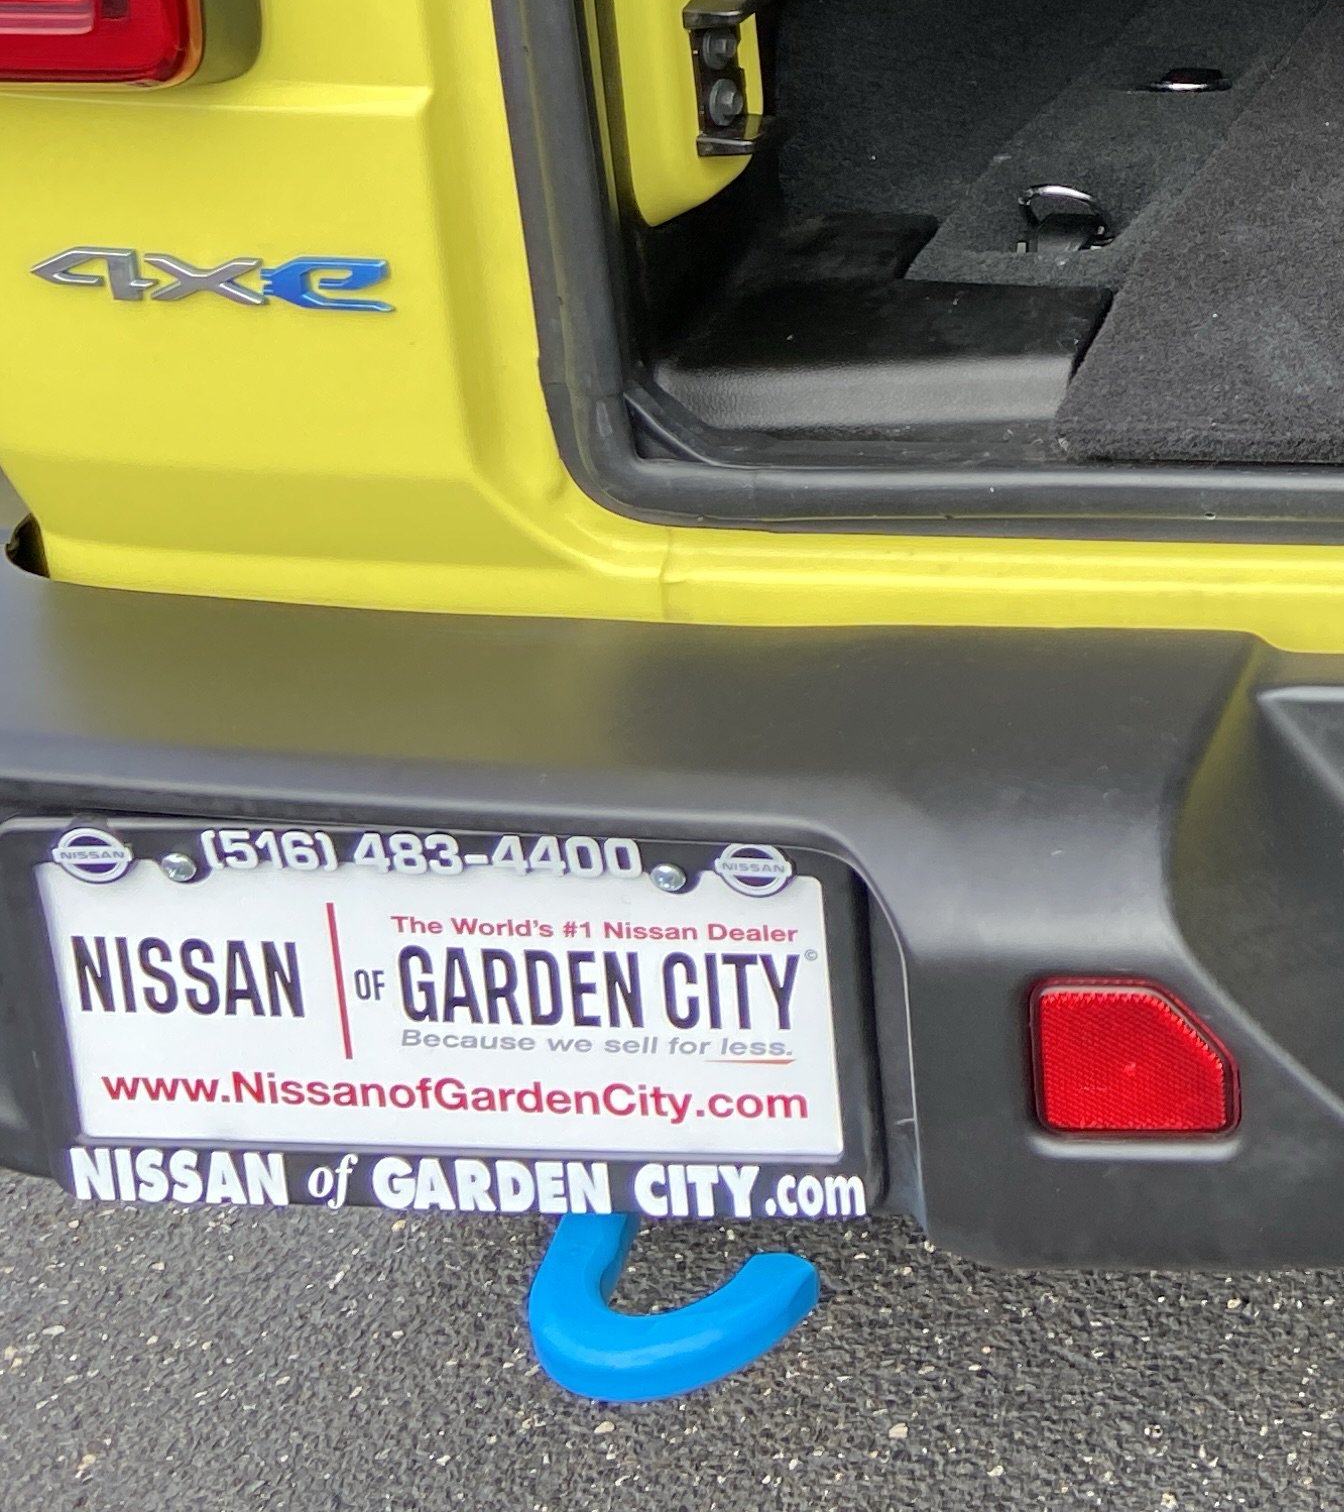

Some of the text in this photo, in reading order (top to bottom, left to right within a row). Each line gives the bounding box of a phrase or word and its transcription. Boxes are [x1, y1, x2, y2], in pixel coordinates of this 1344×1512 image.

[59, 850, 125, 860] NISSAN
[201, 829, 642, 878] (516) 483-4400
[721, 861, 785, 874] NISSAN
[391, 915, 799, 942] The World's #1 Nissan Dealer
[70, 935, 800, 1030] NISSAN OF GARDEN CITY
[401, 1029, 793, 1056] Because we sell for less.
[101, 1071, 809, 1124] www.NissanofGardenCity.com
[69, 1147, 289, 1206] NISSAN
[308, 1153, 358, 1210] of
[372, 1156, 613, 1214] GARDEN
